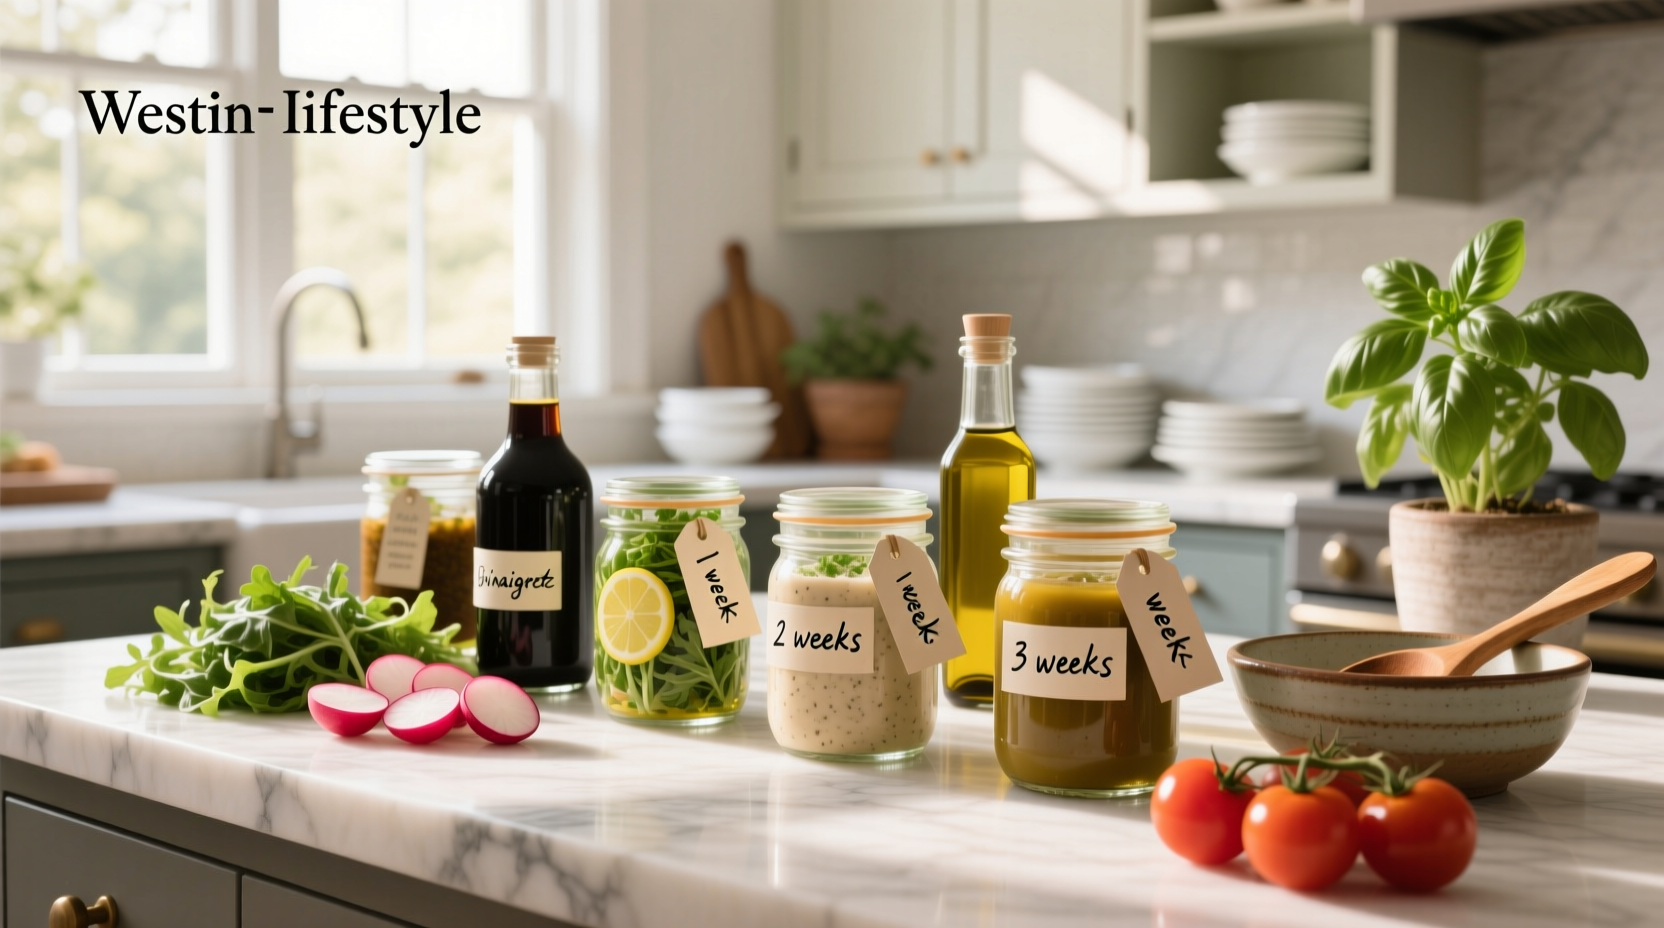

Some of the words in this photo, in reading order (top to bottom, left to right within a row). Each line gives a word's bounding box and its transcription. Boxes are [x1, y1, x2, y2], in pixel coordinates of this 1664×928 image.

[704, 568, 739, 624] week
[773, 619, 786, 647] 2
[793, 620, 862, 653] weeks
[1011, 640, 1027, 672] 3
[1036, 642, 1114, 678] weeks
